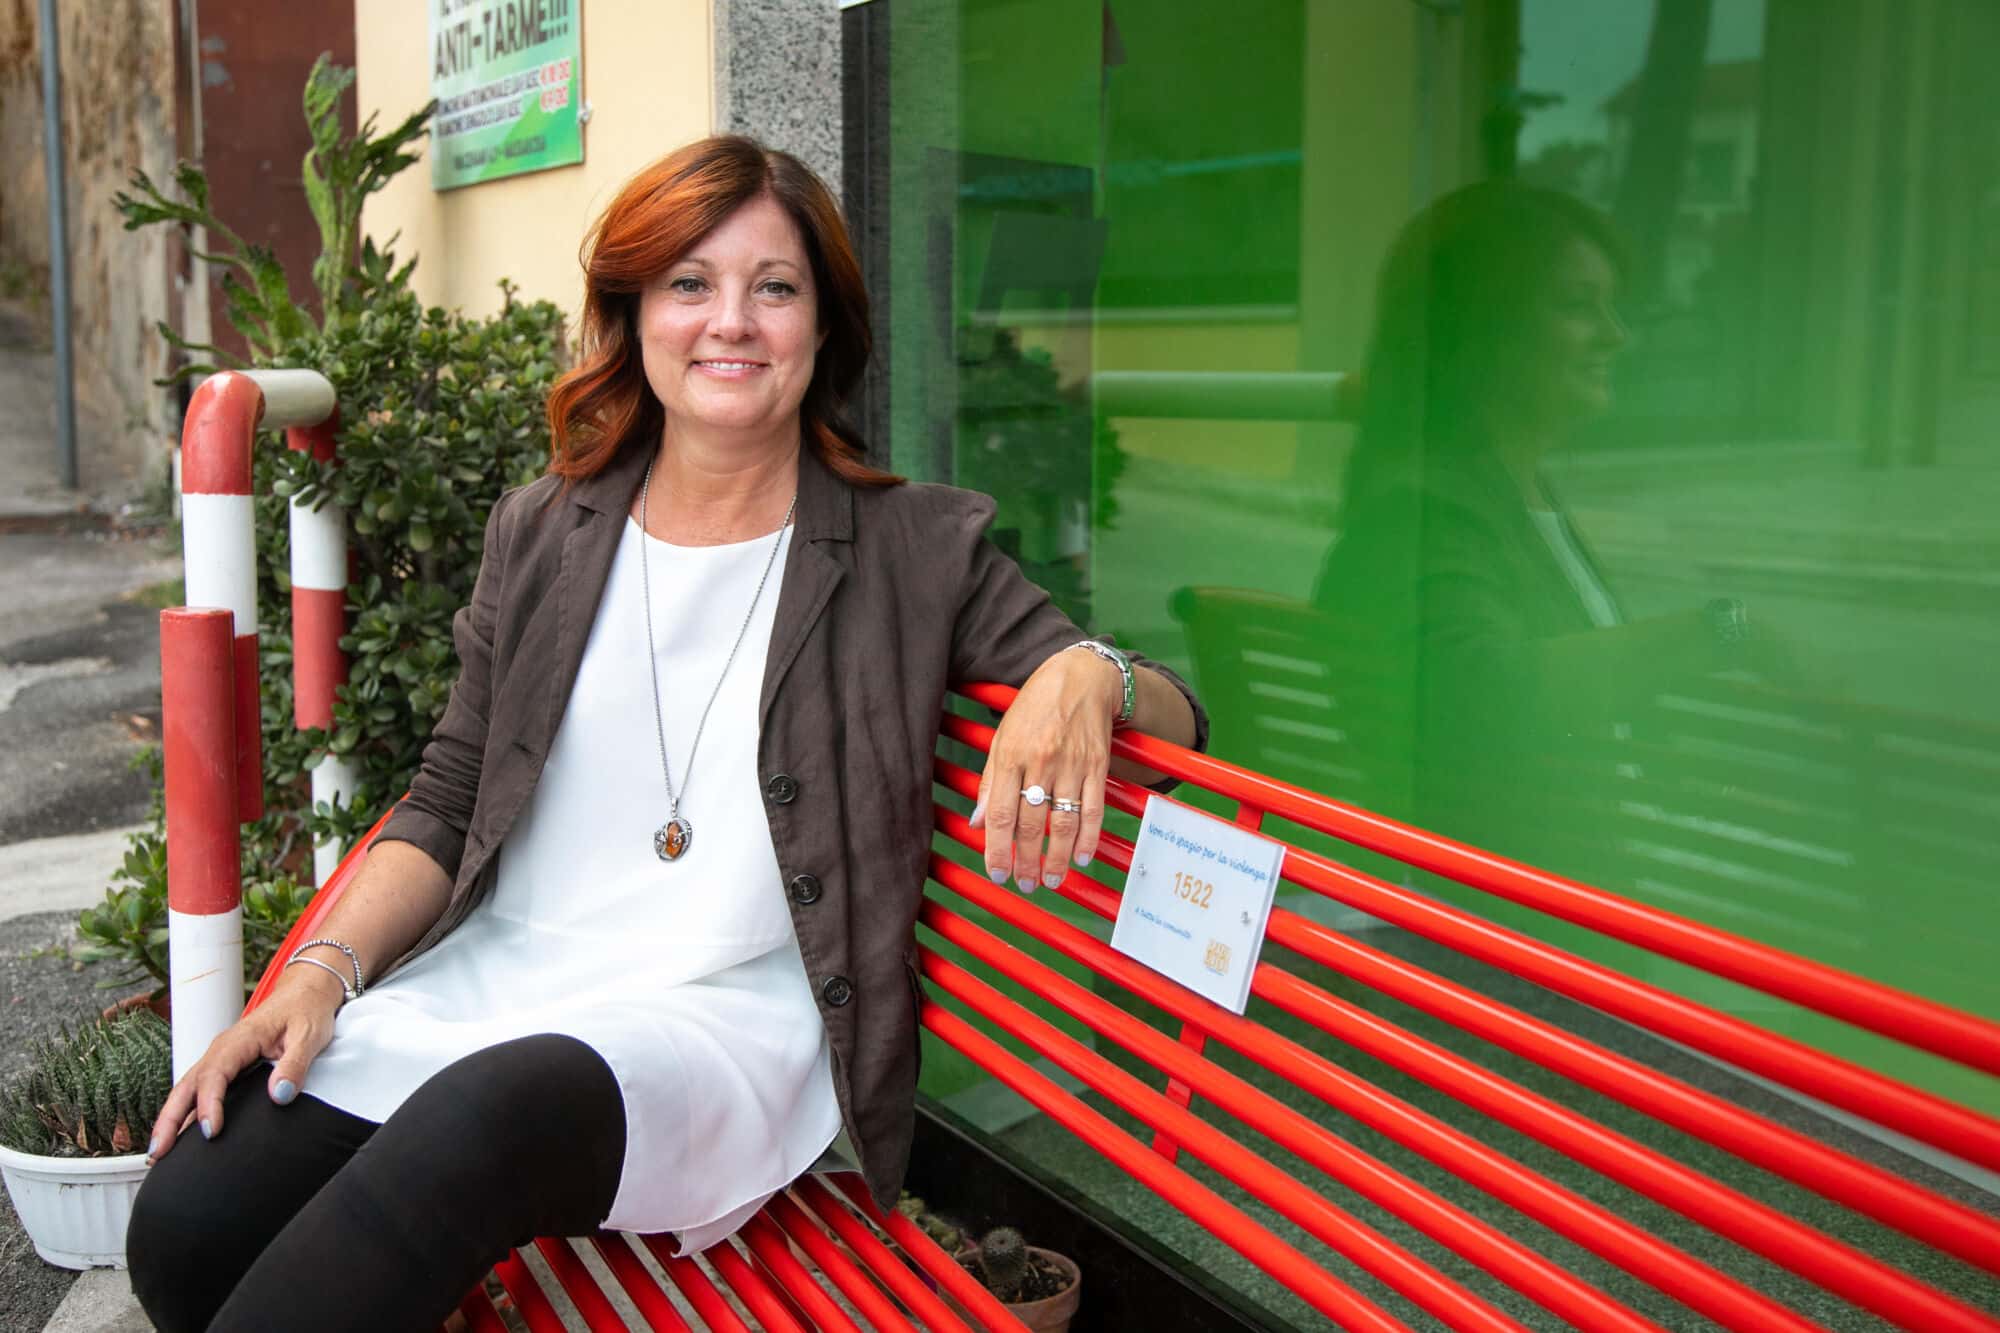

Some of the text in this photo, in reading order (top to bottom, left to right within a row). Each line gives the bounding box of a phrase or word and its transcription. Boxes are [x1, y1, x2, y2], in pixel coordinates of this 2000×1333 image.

[1147, 822, 1163, 838] Non
[1176, 836, 1202, 855] spazio
[1202, 847, 1216, 860] per
[1218, 849, 1227, 864] la
[1230, 859, 1267, 880] violenza
[1173, 871, 1213, 909] 1522
